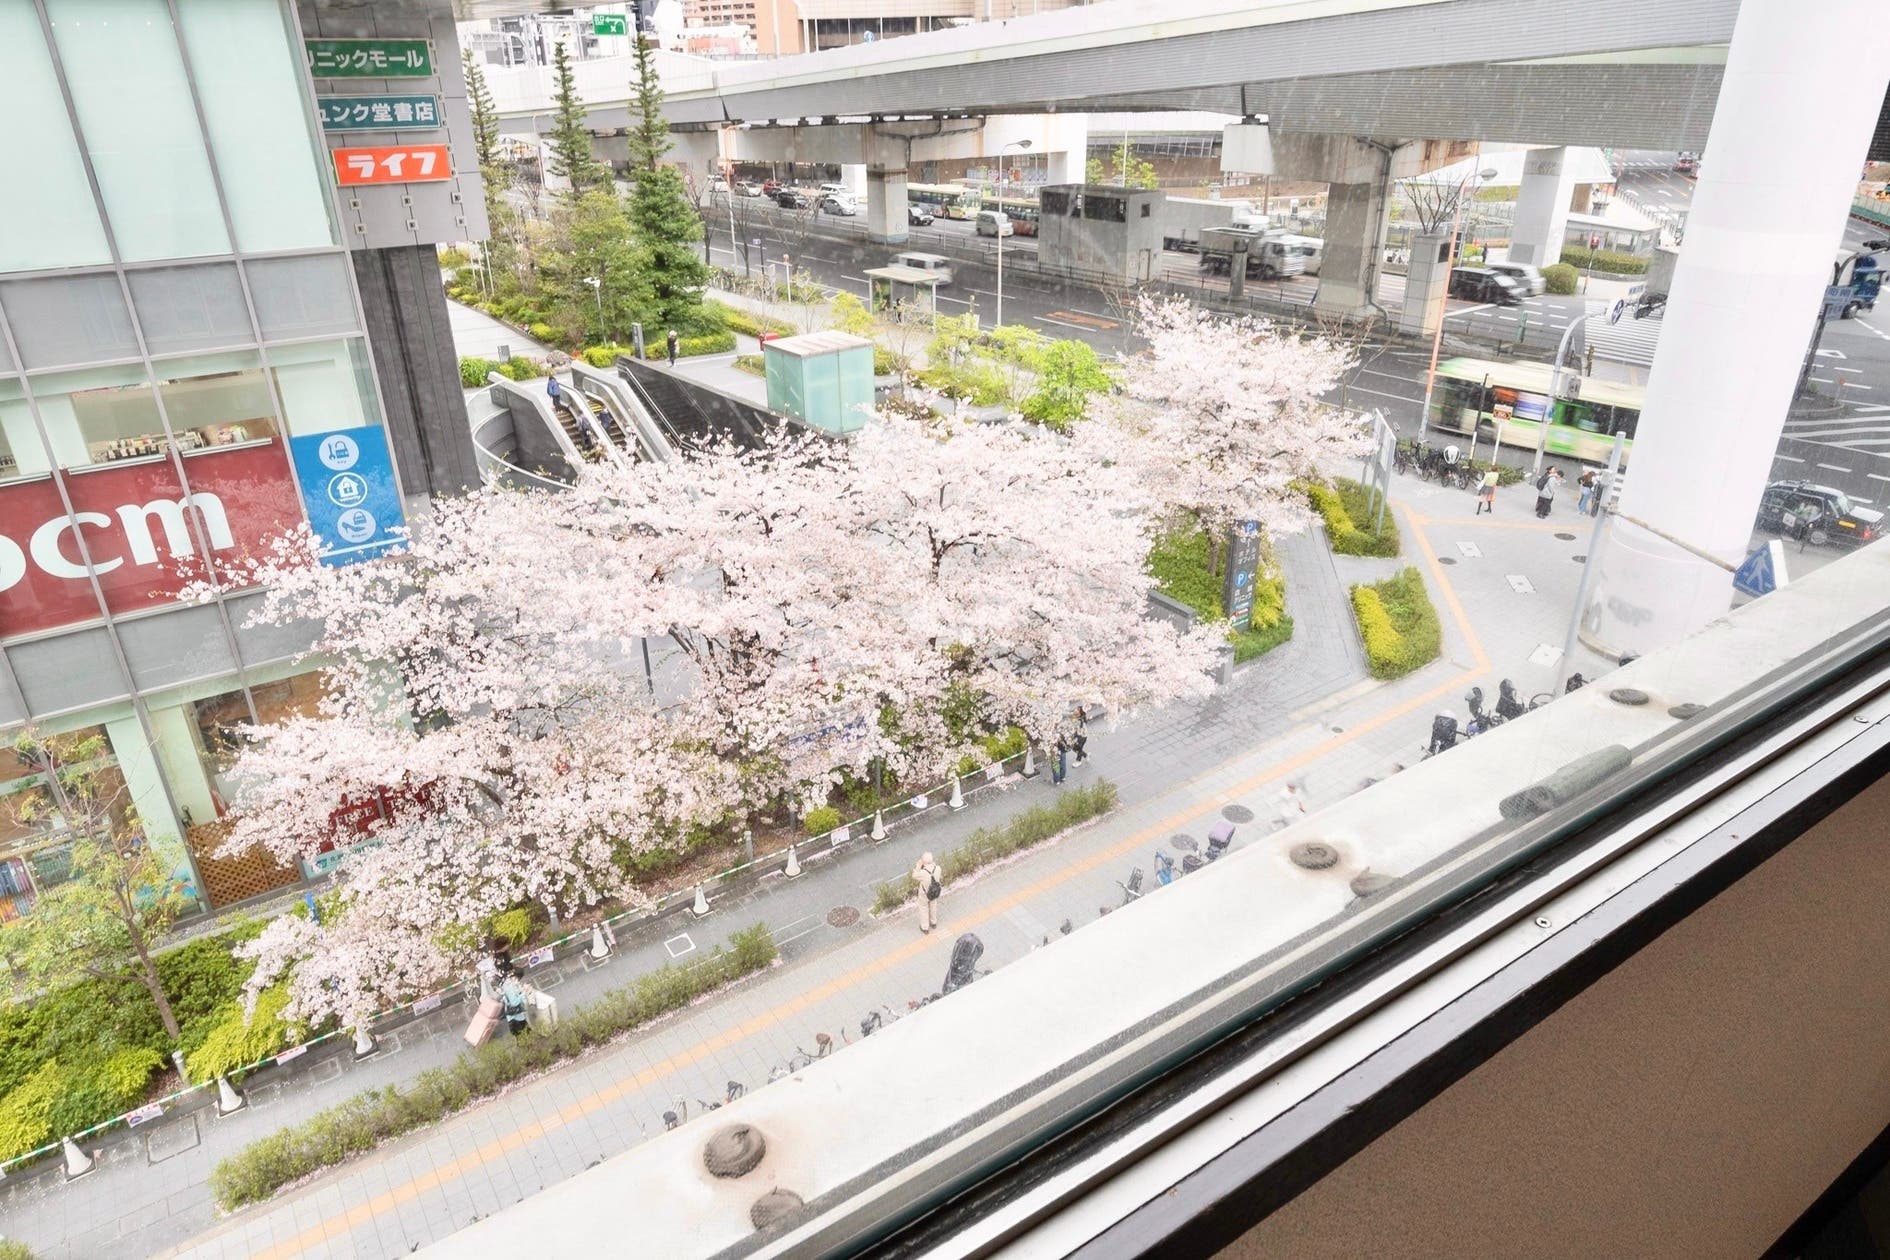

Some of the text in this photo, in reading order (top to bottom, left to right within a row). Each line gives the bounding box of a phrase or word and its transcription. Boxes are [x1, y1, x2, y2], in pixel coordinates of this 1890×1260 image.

[348, 152, 437, 178] ライフ
[1237, 573, 1245, 585] P
